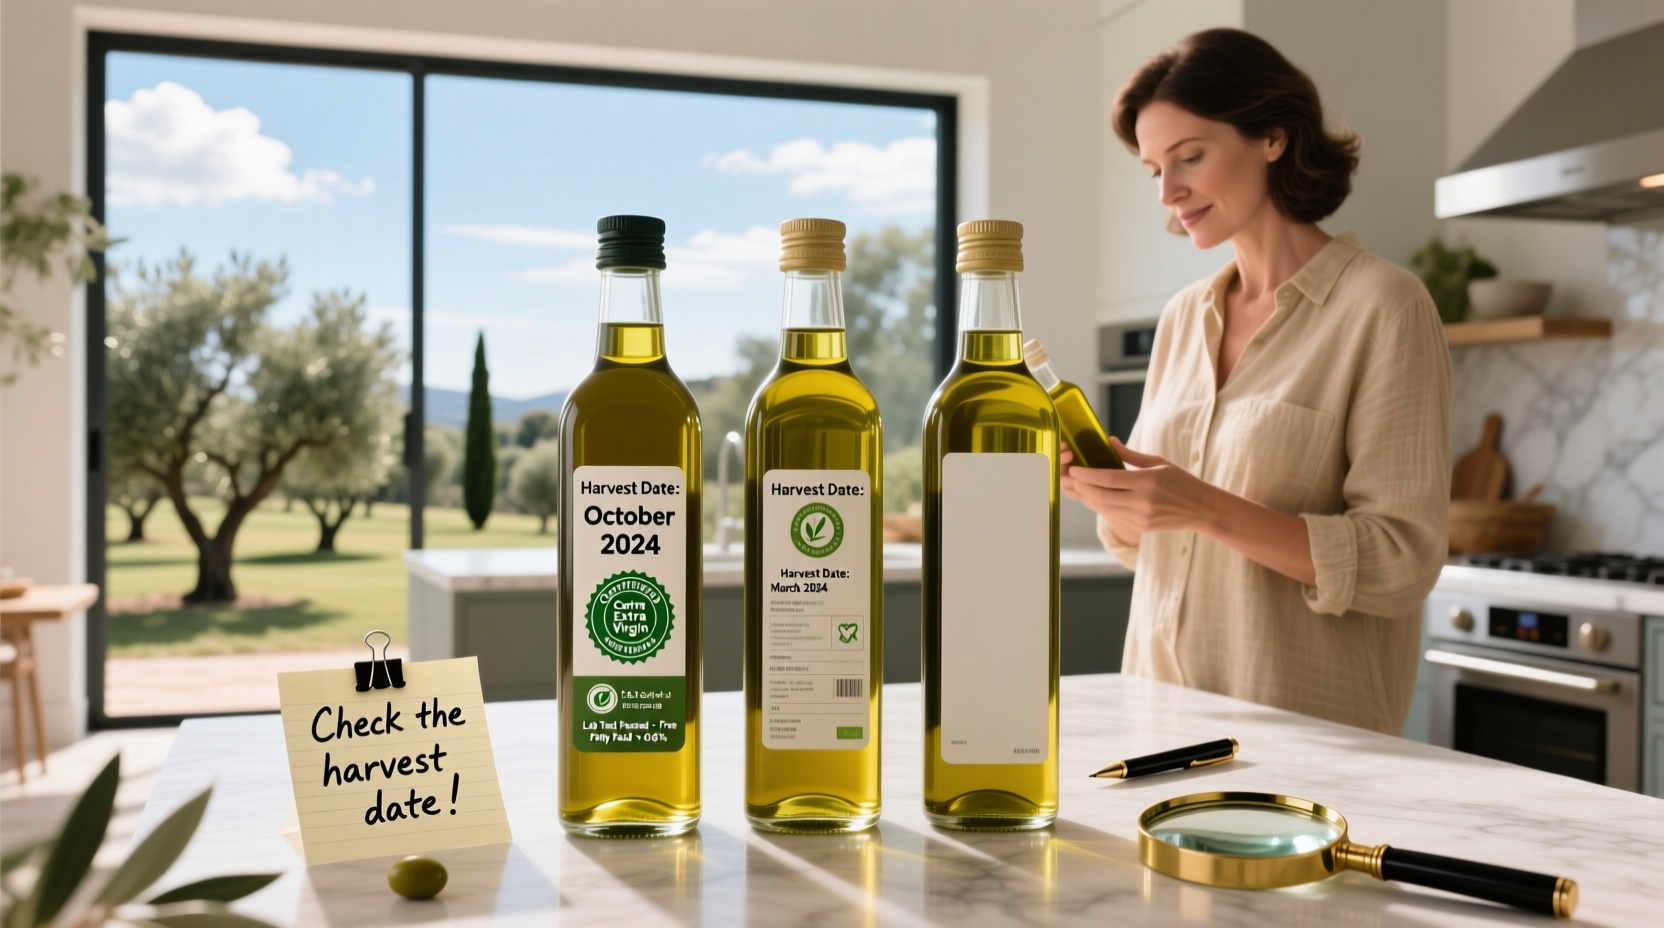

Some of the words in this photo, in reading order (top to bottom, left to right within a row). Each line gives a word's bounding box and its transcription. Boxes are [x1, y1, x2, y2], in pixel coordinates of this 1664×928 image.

[581, 481, 638, 495] Harvest
[641, 481, 680, 495] Date:
[771, 483, 825, 496] Harvest
[828, 483, 864, 496] Date:
[584, 505, 676, 526] October
[601, 533, 661, 555] 2024
[780, 568, 820, 578] Harvest
[822, 568, 850, 578] Date:
[613, 611, 647, 622] Extra
[612, 622, 649, 637] Virgin
[311, 701, 404, 742] Check
[415, 697, 466, 729] the
[323, 743, 447, 787] harvest
